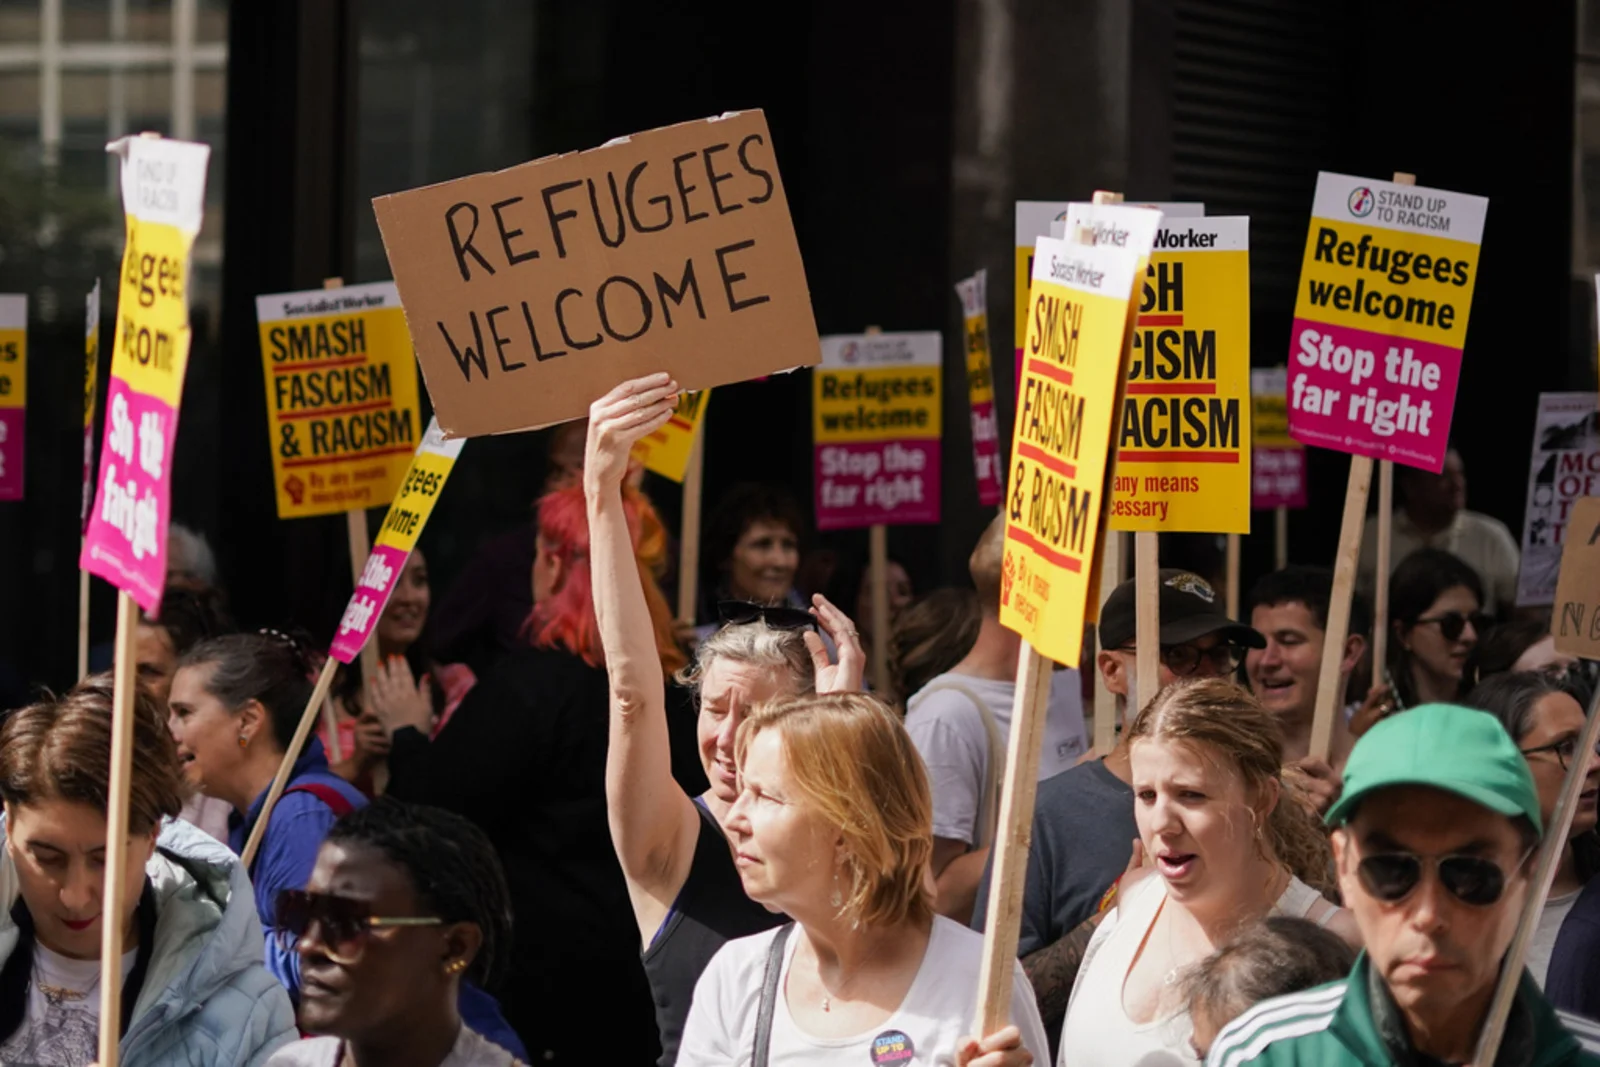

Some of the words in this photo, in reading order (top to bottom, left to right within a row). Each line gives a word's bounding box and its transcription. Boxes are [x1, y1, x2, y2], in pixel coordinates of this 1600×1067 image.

[444, 134, 774, 281] REFUGEES
[1377, 206, 1394, 222] TO
[1397, 210, 1451, 232] RACISM
[1378, 190, 1423, 210] STAND
[1427, 197, 1447, 213] UP
[1314, 227, 1469, 287] Refugees
[437, 239, 770, 383] WELCOME
[1309, 278, 1455, 330] welcome
[270, 318, 366, 362] SMASH
[1128, 329, 1217, 381] CISM
[1297, 329, 1375, 385] Stop
[1384, 347, 1441, 391] the
[274, 363, 392, 411] FASCISM
[822, 372, 935, 404] Refugees
[1291, 373, 1340, 416] far
[1347, 387, 1433, 437] right
[280, 423, 301, 458] &
[310, 408, 413, 455] RACISM
[822, 404, 929, 432] welcome
[1120, 397, 1240, 448] ACISM
[820, 446, 881, 481] Stop
[884, 442, 926, 472] the
[820, 479, 860, 507] far
[864, 474, 924, 511] right
[1111, 499, 1169, 522] cessary
[1115, 476, 1138, 497] any
[1145, 476, 1200, 492] means
